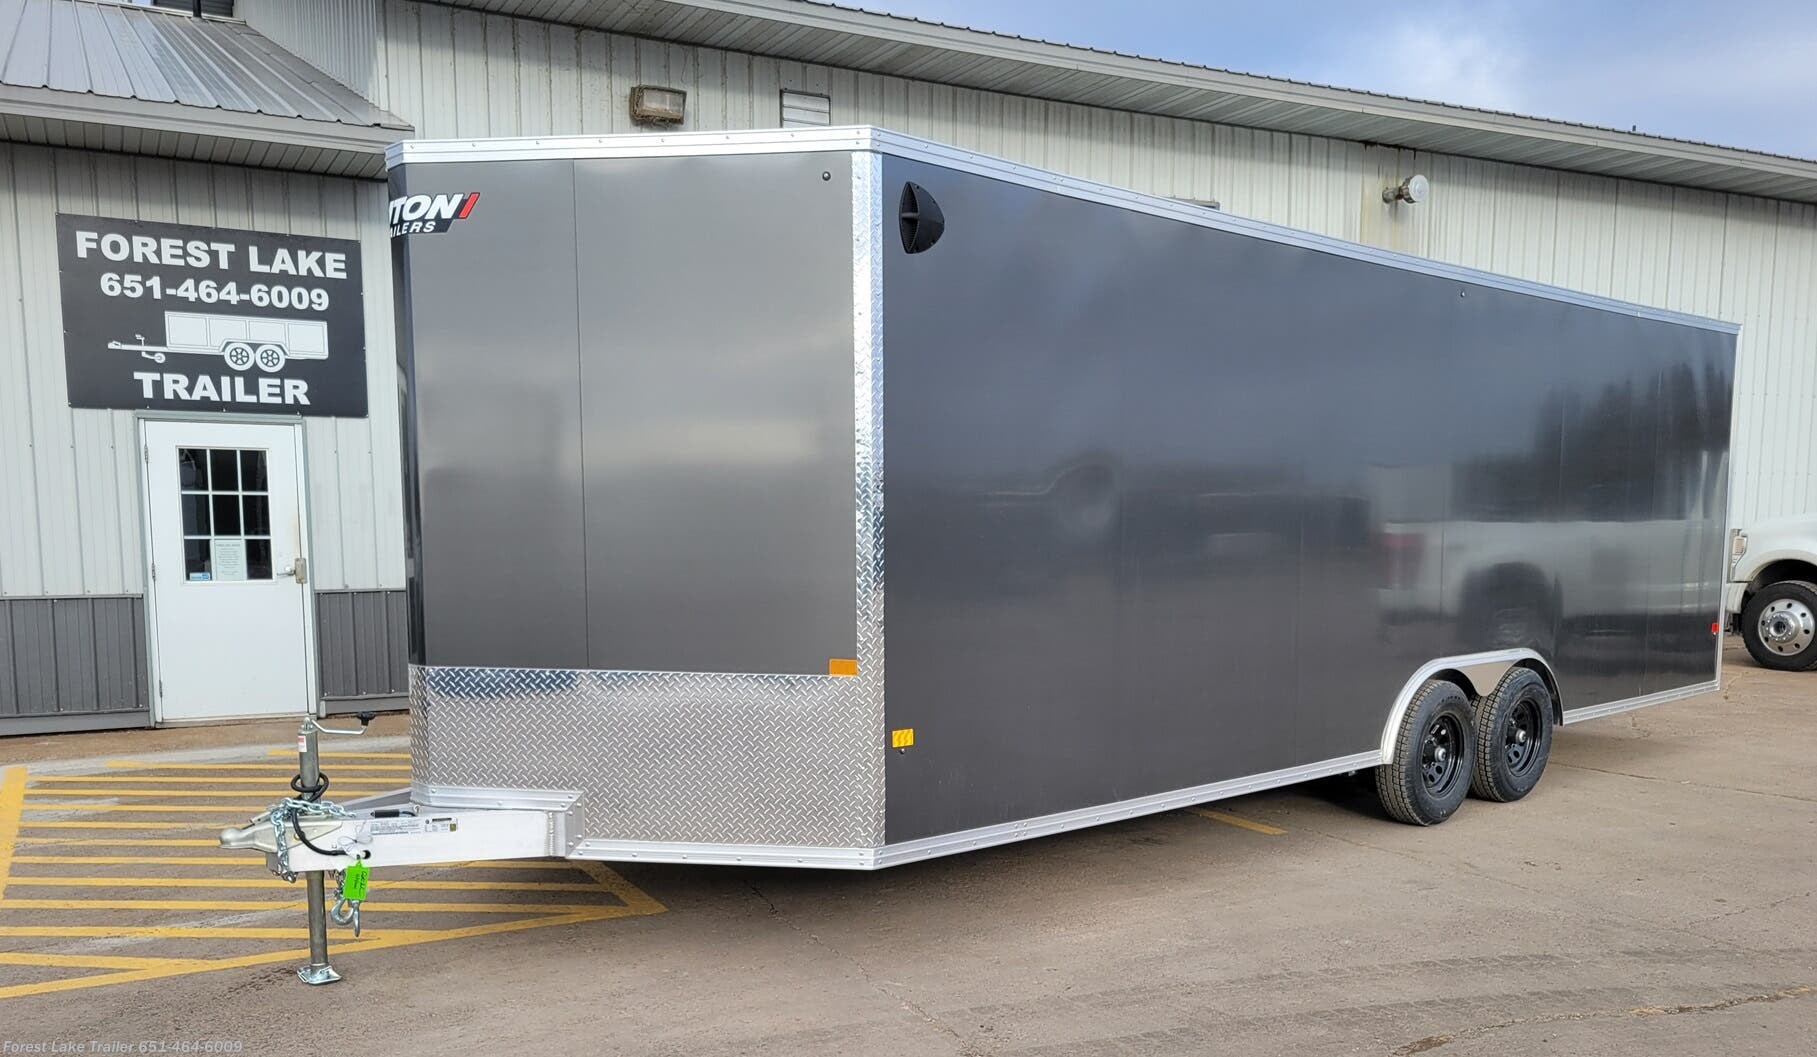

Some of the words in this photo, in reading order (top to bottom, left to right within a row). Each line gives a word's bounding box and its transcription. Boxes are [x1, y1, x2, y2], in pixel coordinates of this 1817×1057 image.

[75, 230, 235, 269] FOREST
[248, 245, 347, 279] LAKE
[100, 272, 329, 311] 651-464-6009
[133, 371, 311, 406] TRAILER
